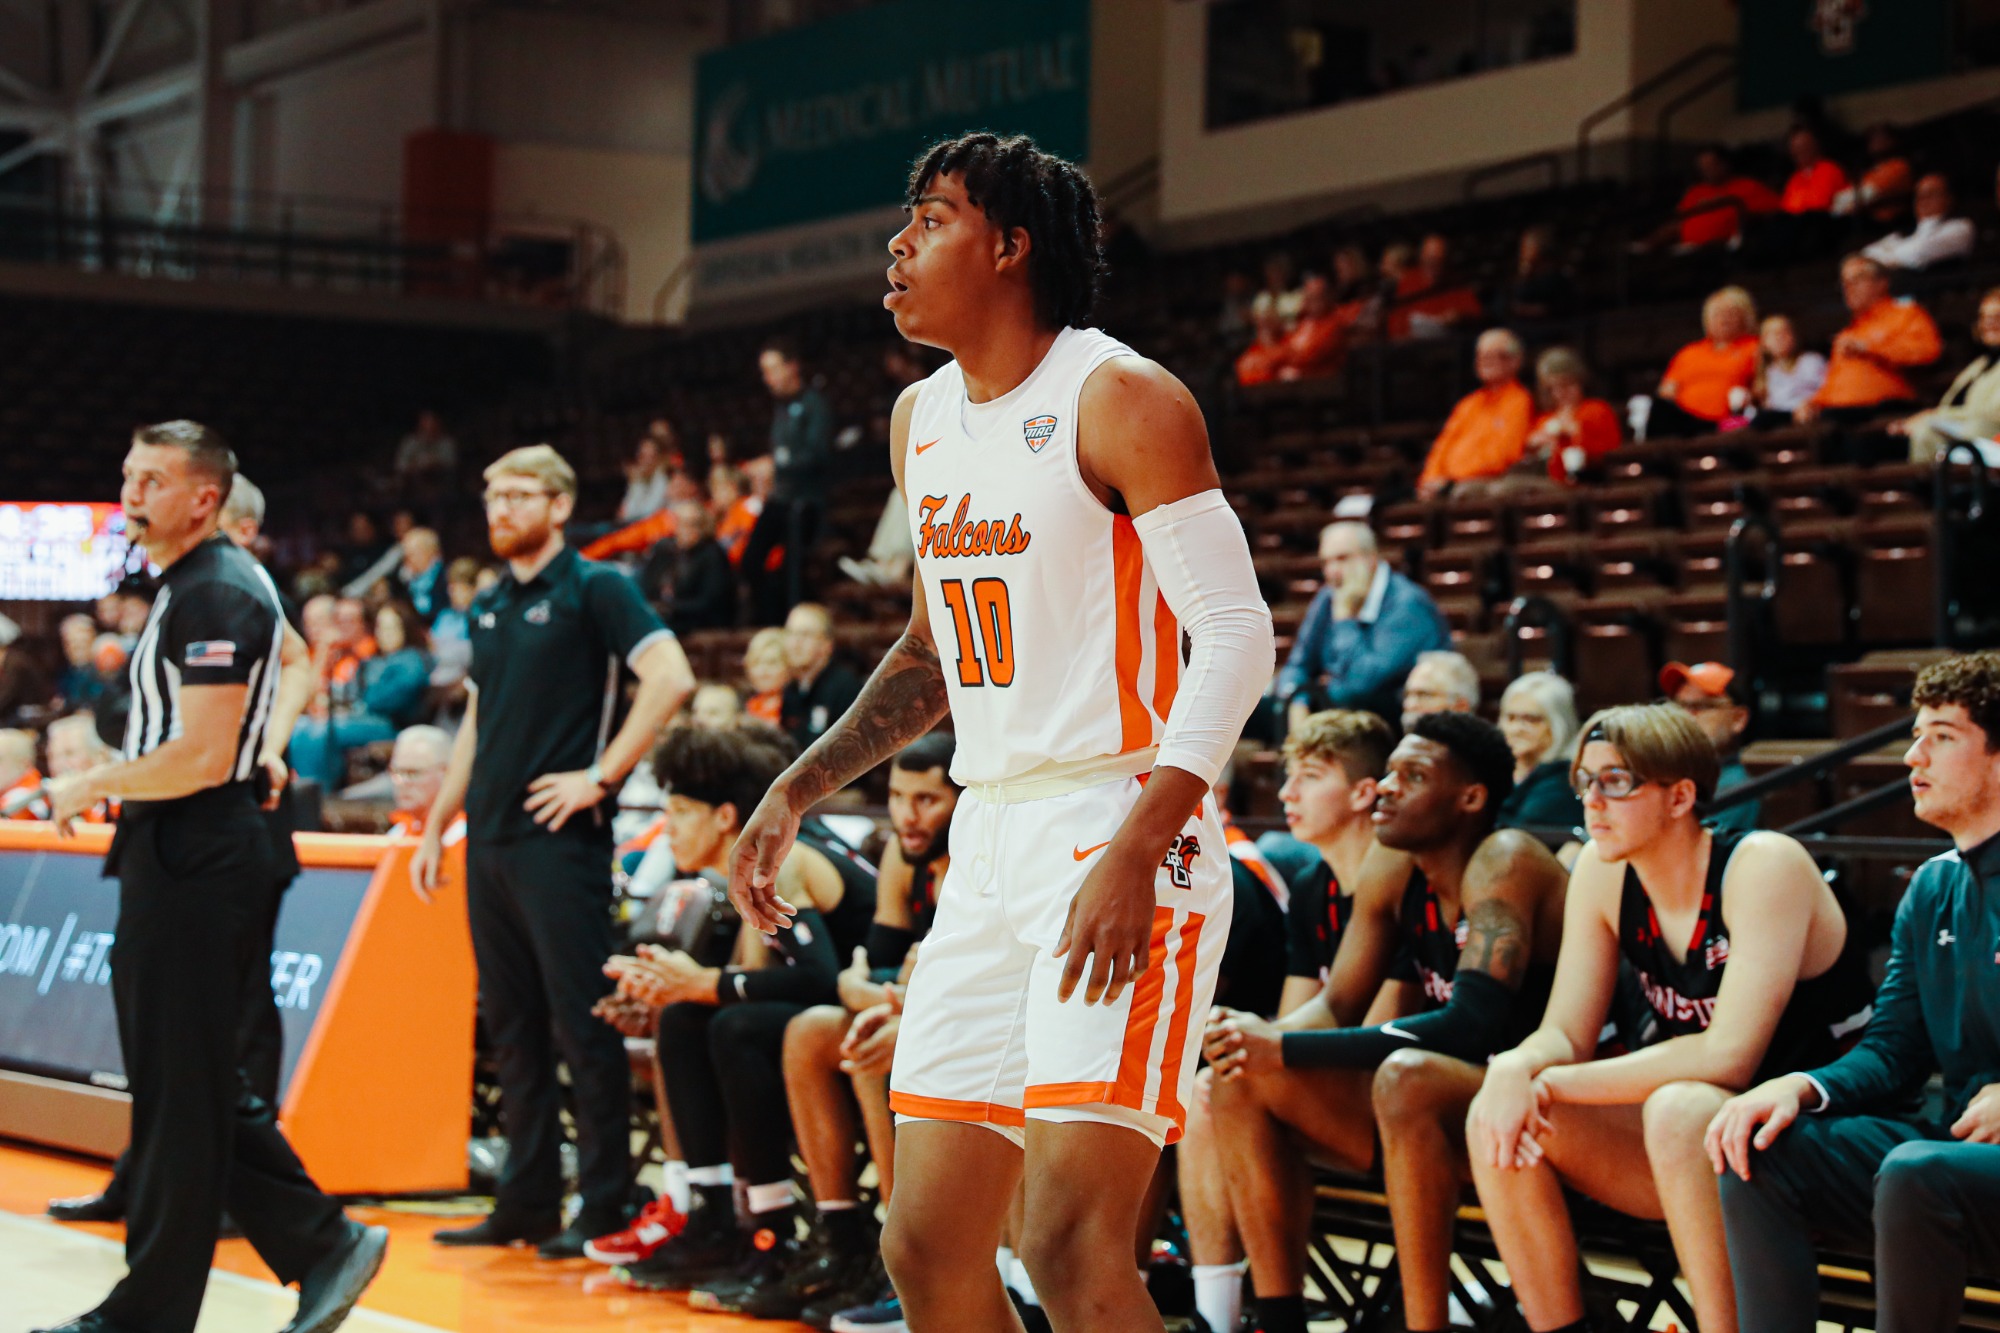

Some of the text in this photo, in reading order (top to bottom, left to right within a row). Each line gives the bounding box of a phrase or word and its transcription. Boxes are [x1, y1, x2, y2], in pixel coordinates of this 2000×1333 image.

[1025, 426, 1055, 438] MAC
[918, 493, 1031, 558] Falcons
[940, 577, 1015, 688] 10
